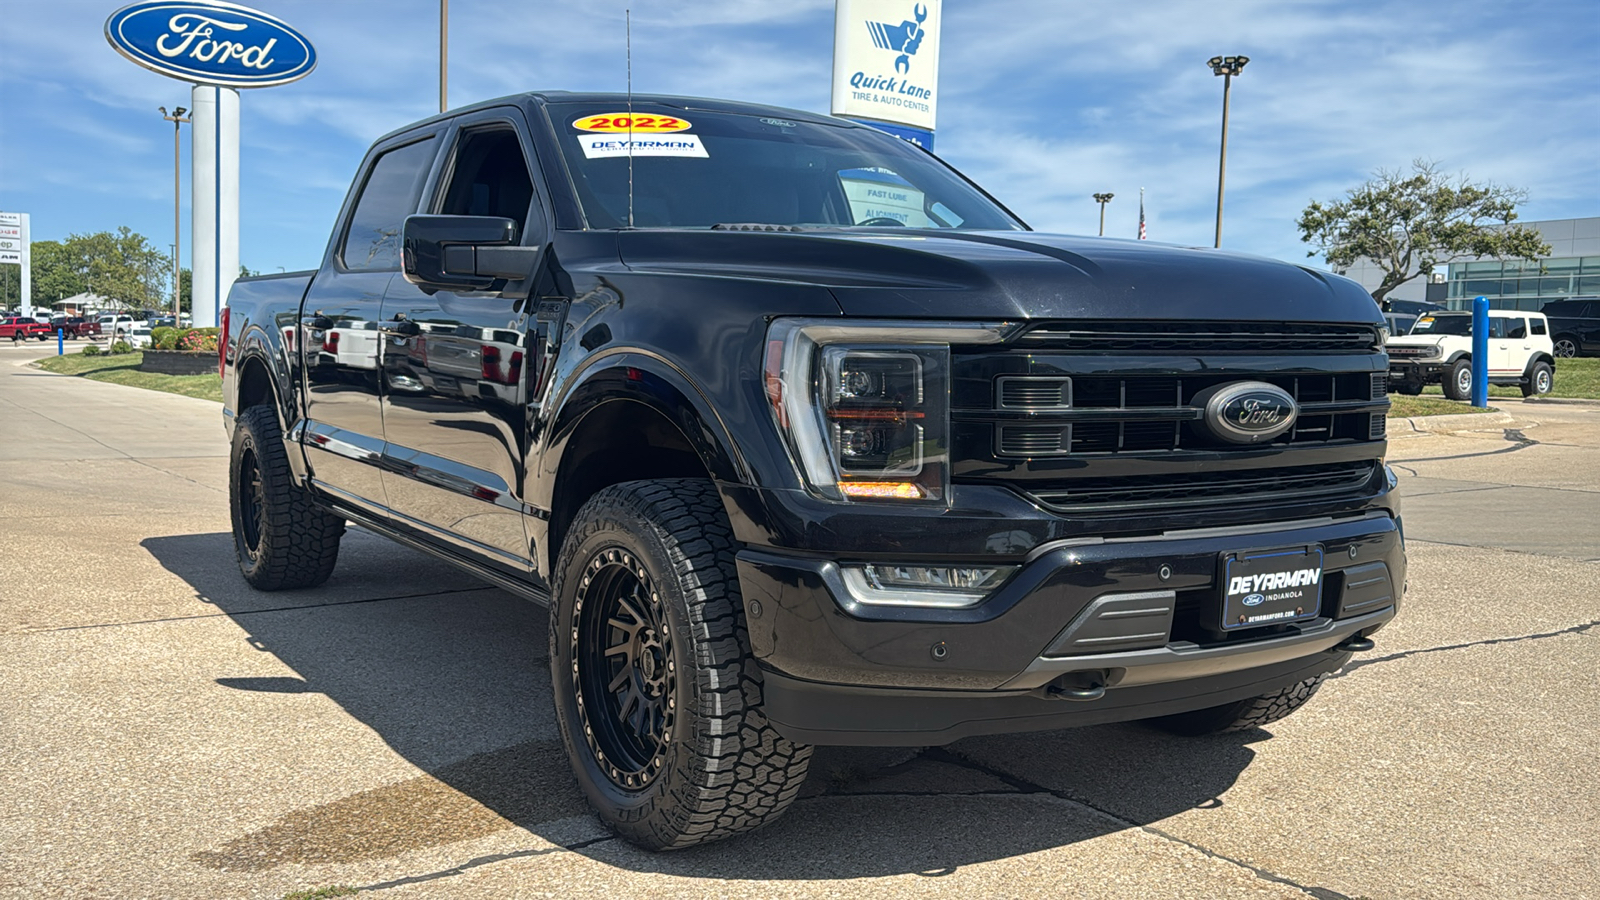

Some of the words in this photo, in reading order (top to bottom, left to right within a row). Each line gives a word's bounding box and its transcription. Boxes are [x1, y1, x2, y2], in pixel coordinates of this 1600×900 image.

[156, 13, 278, 69] Ford
[850, 71, 897, 92] Quick
[898, 80, 931, 100] Lane
[852, 91, 872, 102] TIRE
[872, 94, 879, 102] &
[880, 95, 902, 106] AUTO
[903, 100, 930, 113] CENTER
[589, 117, 680, 128] 2022
[591, 140, 695, 149] DEYARMAN
[867, 189, 888, 199] FAST
[888, 191, 908, 202] LUBE
[865, 209, 909, 223] ALIGNMENT
[1238, 398, 1281, 424] Ford
[1228, 568, 1321, 596] DEYARMAN
[1265, 590, 1303, 602] INDIANOLA
[1248, 610, 1295, 623] DEYARMANFORD.COM
